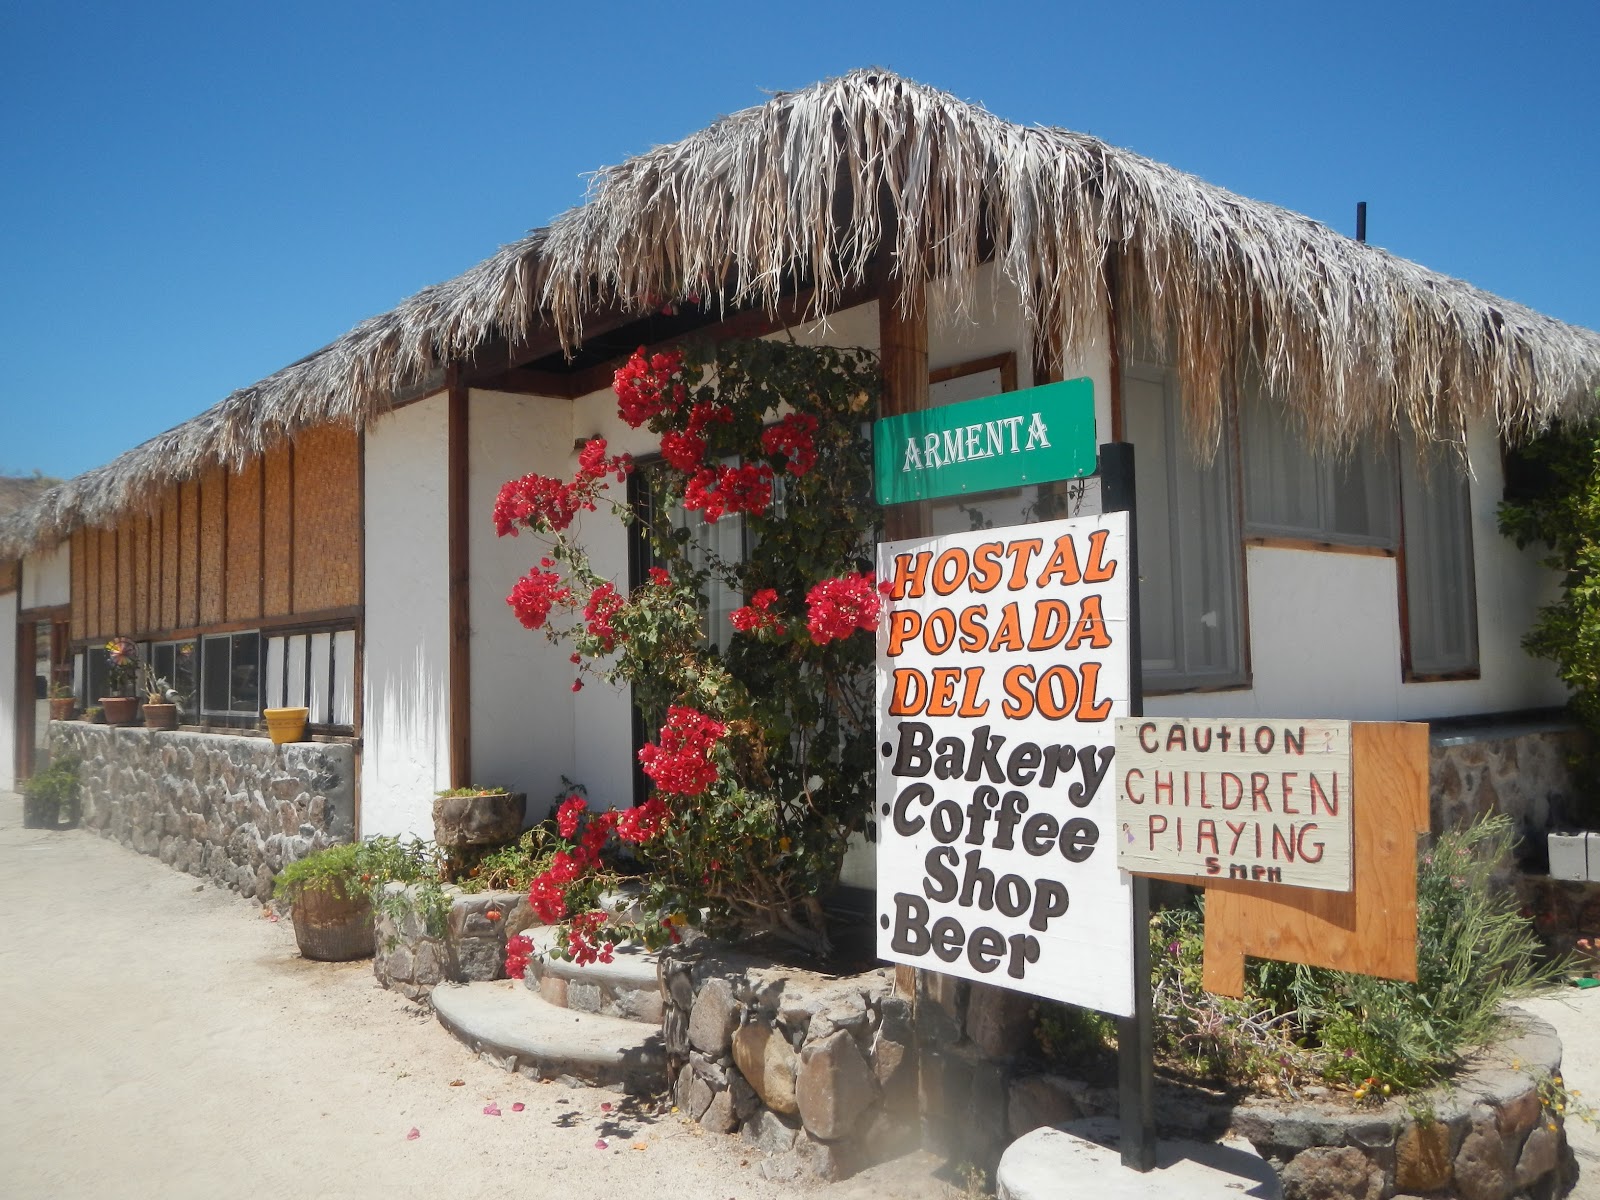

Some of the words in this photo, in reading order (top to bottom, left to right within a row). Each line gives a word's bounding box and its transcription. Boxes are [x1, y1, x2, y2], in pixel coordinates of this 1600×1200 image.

[902, 412, 1051, 472] ARMENTA
[889, 529, 1117, 601] HOSTAL
[887, 594, 1112, 657] POSADA
[888, 667, 990, 717] DEL
[1001, 662, 1113, 722] SOL
[891, 722, 1116, 807] Bakery
[1125, 768, 1339, 816] CHILDREN
[893, 782, 1100, 863] Coffee
[923, 846, 1069, 932] Shop
[891, 892, 1041, 979] Beer
